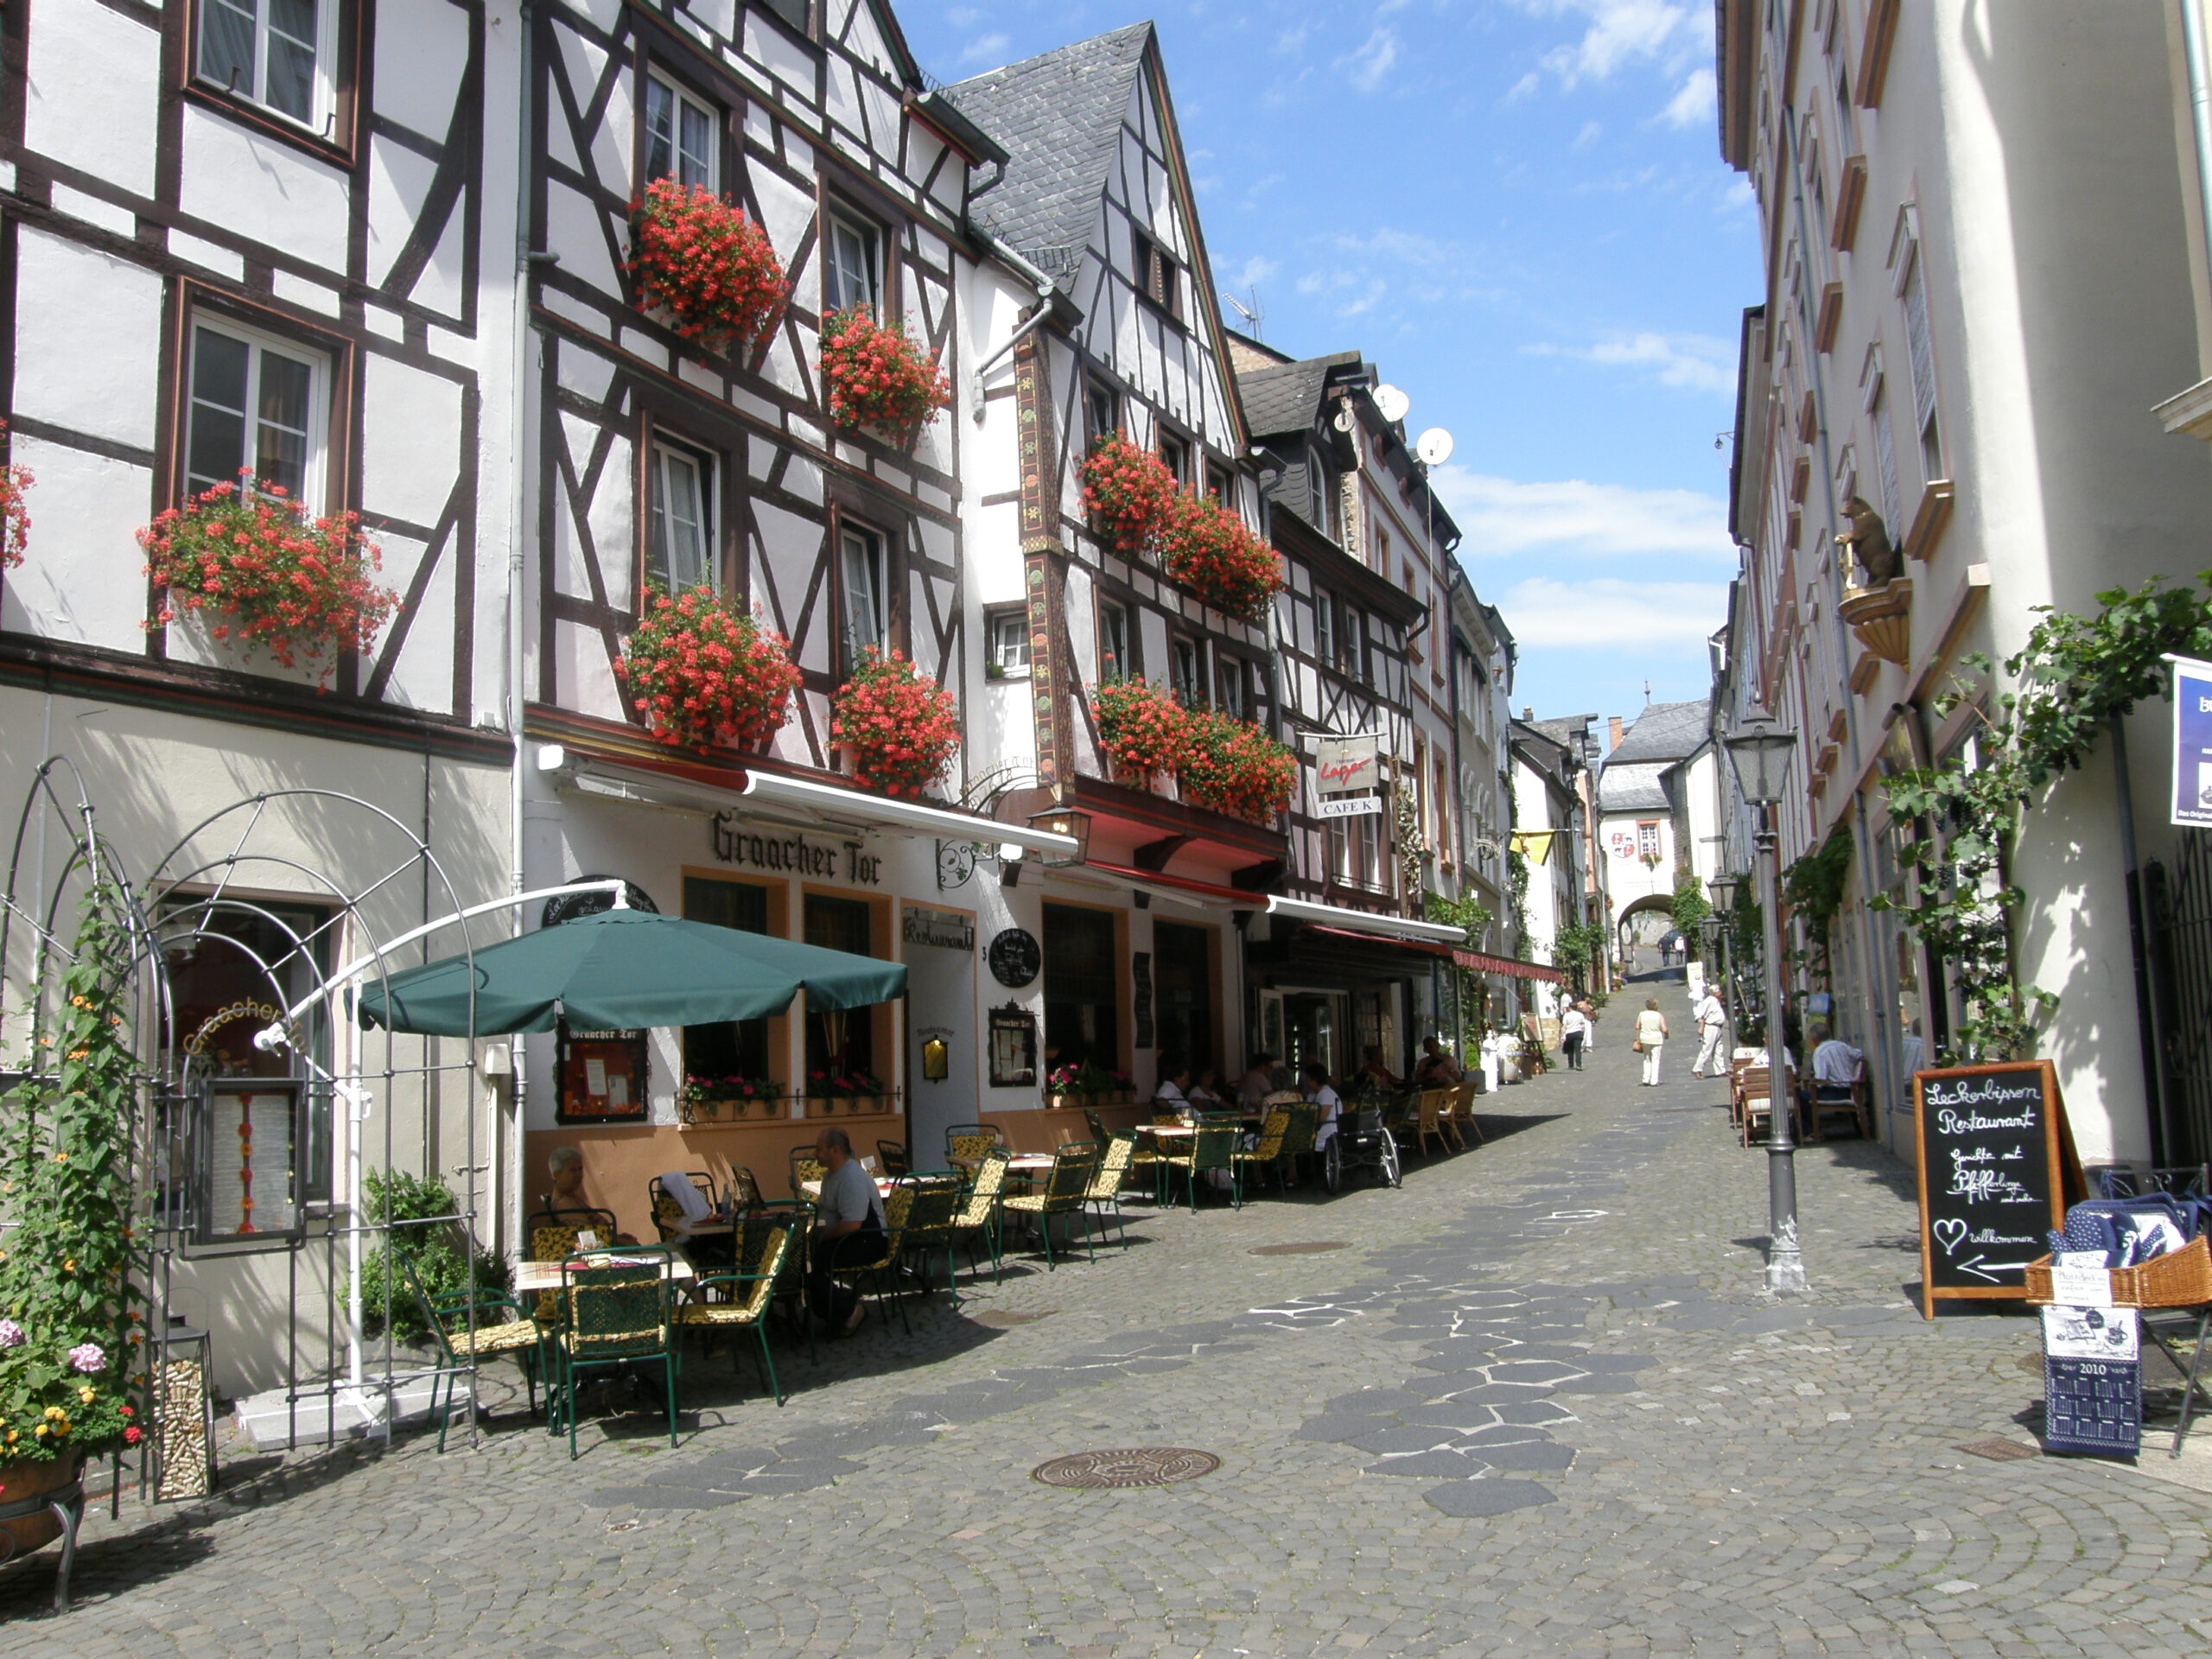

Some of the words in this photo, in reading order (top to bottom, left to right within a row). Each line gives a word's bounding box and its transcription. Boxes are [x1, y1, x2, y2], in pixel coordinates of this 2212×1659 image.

[1324, 802, 1358, 815] CAFE
[1363, 800, 1372, 810] K
[713, 810, 837, 879] Graacher
[842, 841, 882, 886] Tor
[183, 996, 282, 1055] Graacher
[286, 1018, 309, 1057] Tor
[619, 1029, 638, 1039] Tor
[1925, 1079, 2041, 1105] Leckerbissen
[1938, 1105, 2036, 1134] Restaurant
[1950, 1147, 1996, 1171] Gerichte
[2001, 1145, 2024, 1160] mit
[2080, 1363, 2107, 1375] 2010
